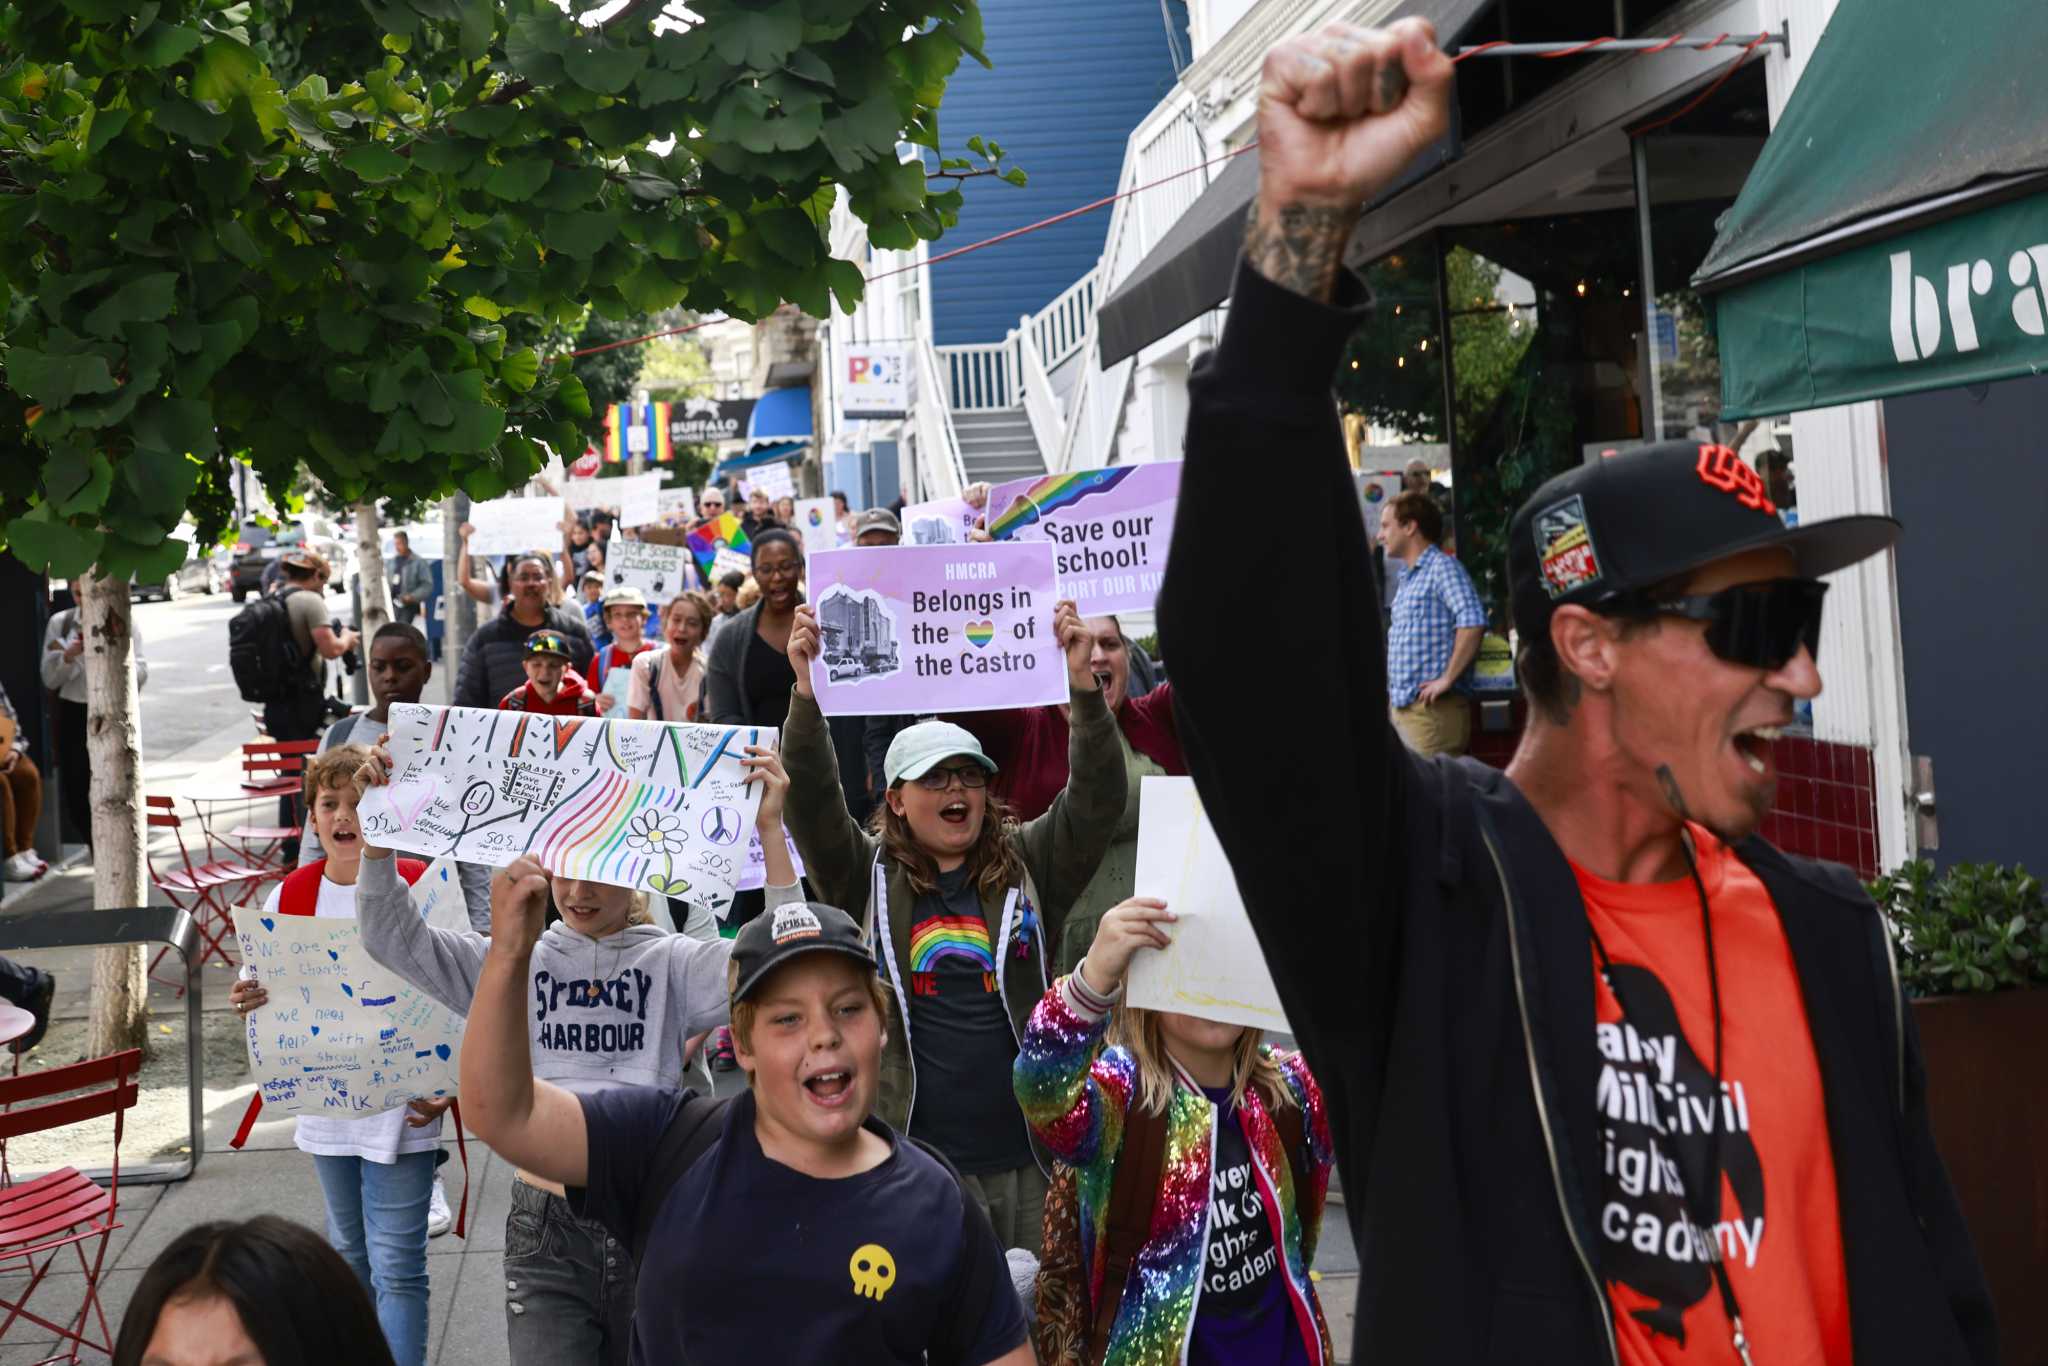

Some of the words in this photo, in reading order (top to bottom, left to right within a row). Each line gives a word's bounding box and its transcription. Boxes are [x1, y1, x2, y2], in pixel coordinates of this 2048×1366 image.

[671, 418, 739, 435] BUFFALO
[1043, 521, 1105, 546] Save
[1112, 514, 1154, 540] our
[610, 542, 646, 558] STOP
[1056, 541, 1149, 575] school!
[622, 556, 677, 573] CLOSURES
[944, 562, 998, 582] HMCRA
[1103, 575, 1134, 598] OUR
[912, 589, 1005, 617] Belongs
[1011, 586, 1033, 609] in
[911, 622, 950, 645] the
[1012, 615, 1036, 640] of
[914, 654, 953, 677] the
[959, 649, 1037, 676] Castro
[620, 735, 639, 744] We
[517, 771, 541, 785] Save
[522, 783, 543, 793] our
[484, 831, 515, 847] SOS
[698, 850, 733, 875] SOS
[290, 940, 321, 954] are
[534, 968, 653, 1023] SYDNEY
[539, 1022, 646, 1054] HARBOUR
